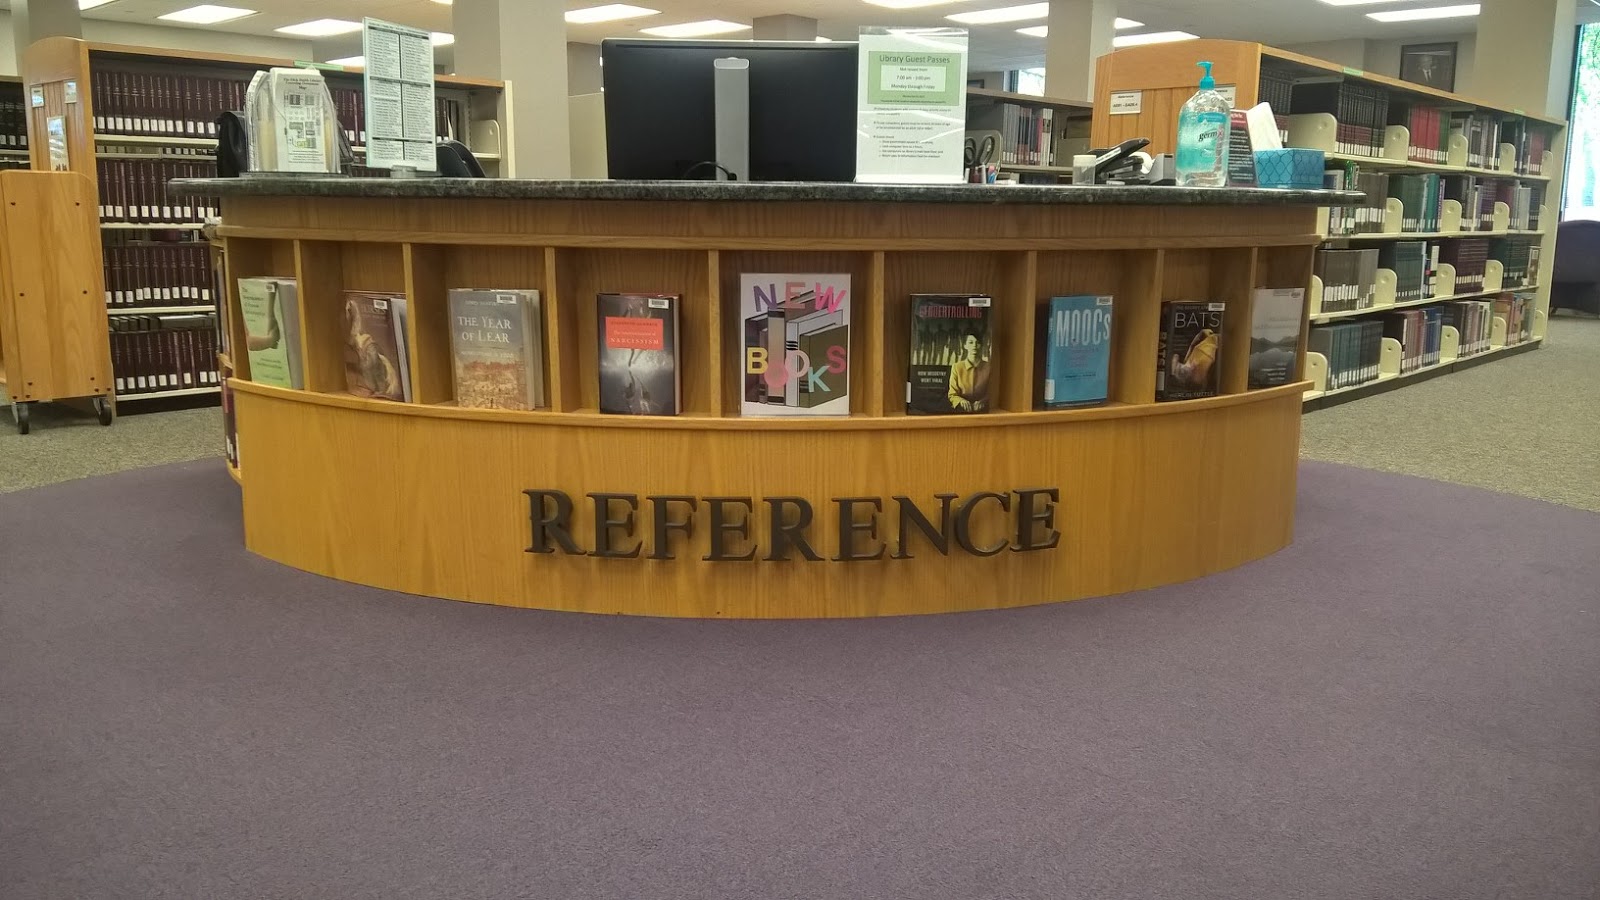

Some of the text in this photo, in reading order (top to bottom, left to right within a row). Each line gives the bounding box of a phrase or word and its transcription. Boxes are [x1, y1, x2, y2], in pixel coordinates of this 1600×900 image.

[879, 55, 951, 64] Library Guest Passes
[753, 281, 848, 315] NEW
[918, 304, 983, 319] GENDERTROLLING
[457, 316, 512, 330] THE YEAR
[1174, 312, 1221, 329] BATS
[461, 330, 510, 344] OF LEAR
[610, 337, 659, 345] NARCISSISM
[746, 344, 848, 394] BOOKS
[523, 487, 1062, 562] REFERENCE
